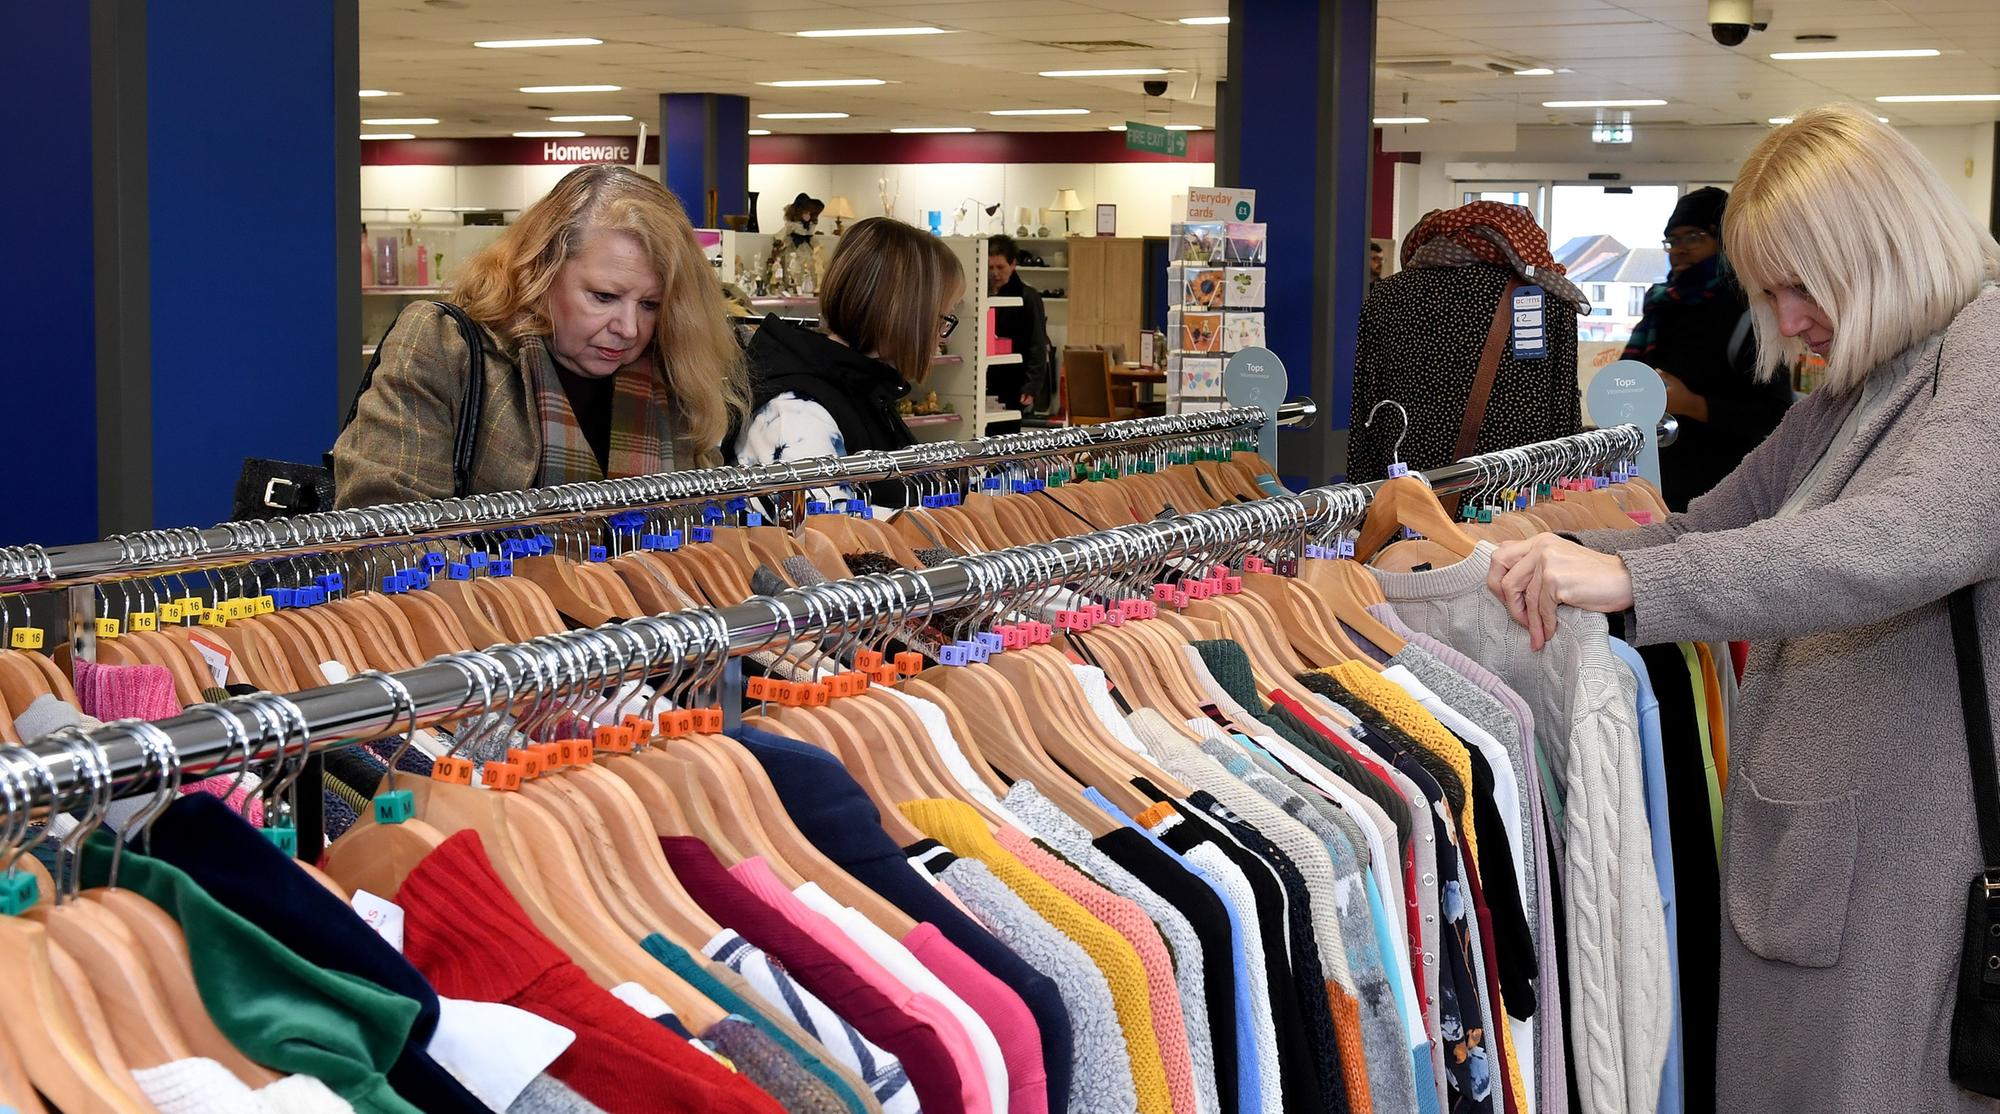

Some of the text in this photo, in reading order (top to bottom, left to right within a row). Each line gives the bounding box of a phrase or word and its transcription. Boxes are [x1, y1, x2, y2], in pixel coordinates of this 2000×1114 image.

[1127, 129, 1165, 147] FIRE EXIT
[543, 141, 629, 161] Homeware
[1190, 191, 1232, 205] Everyday
[1189, 206, 1214, 218] cards
[1246, 363, 1264, 373] Tops
[1613, 378, 1636, 387] Tops
[1247, 561, 1253, 569] S
[1193, 585, 1197, 593] S
[1226, 583, 1232, 591] S
[1159, 590, 1165, 598] S
[1204, 589, 1208, 597] S
[190, 602, 199, 610] 16
[244, 604, 253, 613] 16
[261, 600, 271, 609] 16
[1144, 605, 1148, 614] S
[169, 608, 179, 617] 16
[202, 612, 211, 620] 16
[230, 607, 238, 616] 16
[1096, 610, 1101, 618] S
[138, 618, 151, 626] 16
[216, 614, 225, 623] 16
[1060, 614, 1065, 622] S
[1073, 614, 1078, 623] S
[1109, 614, 1115, 622] S
[104, 623, 115, 633] 16
[1083, 619, 1088, 628] S
[1009, 632, 1013, 641] S
[1034, 627, 1038, 636] S
[16, 633, 24, 642] 16
[32, 633, 41, 642] 16
[995, 640, 1000, 650] 8
[945, 651, 952, 660] 8
[975, 647, 979, 656] 8
[981, 649, 987, 658] 8
[859, 657, 870, 667] 10
[897, 661, 907, 670] 10
[752, 683, 763, 695] 10
[841, 682, 848, 692] 10
[857, 680, 864, 690] 10
[780, 688, 790, 700] 10
[817, 692, 825, 703] 10
[661, 721, 671, 732] 10
[678, 720, 688, 731] 10
[693, 716, 702, 727] 10
[710, 716, 720, 727] 10
[600, 733, 611, 745] 10
[619, 735, 628, 746] 10
[578, 746, 588, 758] 10
[547, 753, 557, 765] 10
[438, 763, 452, 776] 10
[459, 766, 469, 778] 10
[526, 761, 536, 774] 10
[486, 769, 498, 783] 10
[506, 774, 516, 786] 10
[380, 806, 393, 819] M
[403, 804, 411, 815] M
[280, 838, 291, 849] M
